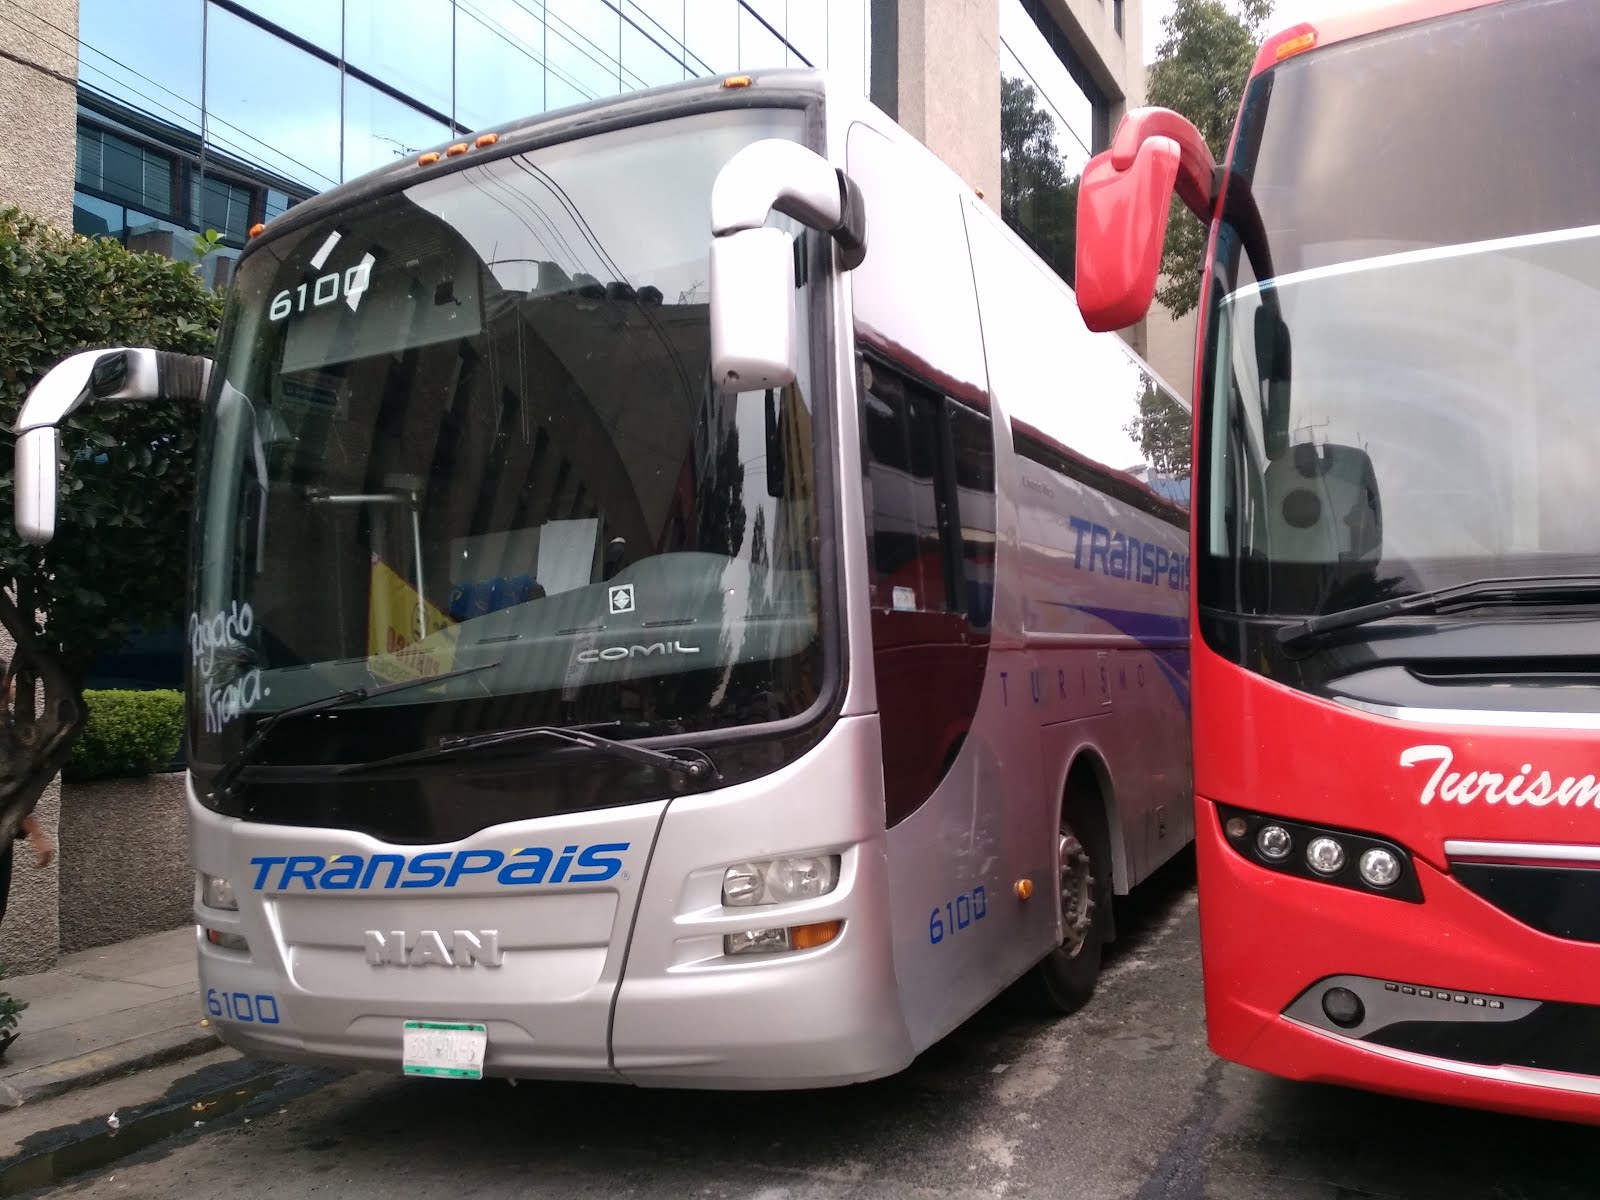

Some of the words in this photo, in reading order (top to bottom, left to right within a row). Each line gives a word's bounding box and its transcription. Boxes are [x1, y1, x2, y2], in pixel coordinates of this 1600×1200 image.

[269, 263, 370, 320] 6100
[577, 640, 700, 662] COMIL
[1000, 663, 1145, 707] TURISMO
[929, 885, 986, 944] 6100
[364, 930, 500, 967] MAN
[207, 988, 279, 1024] 6100
